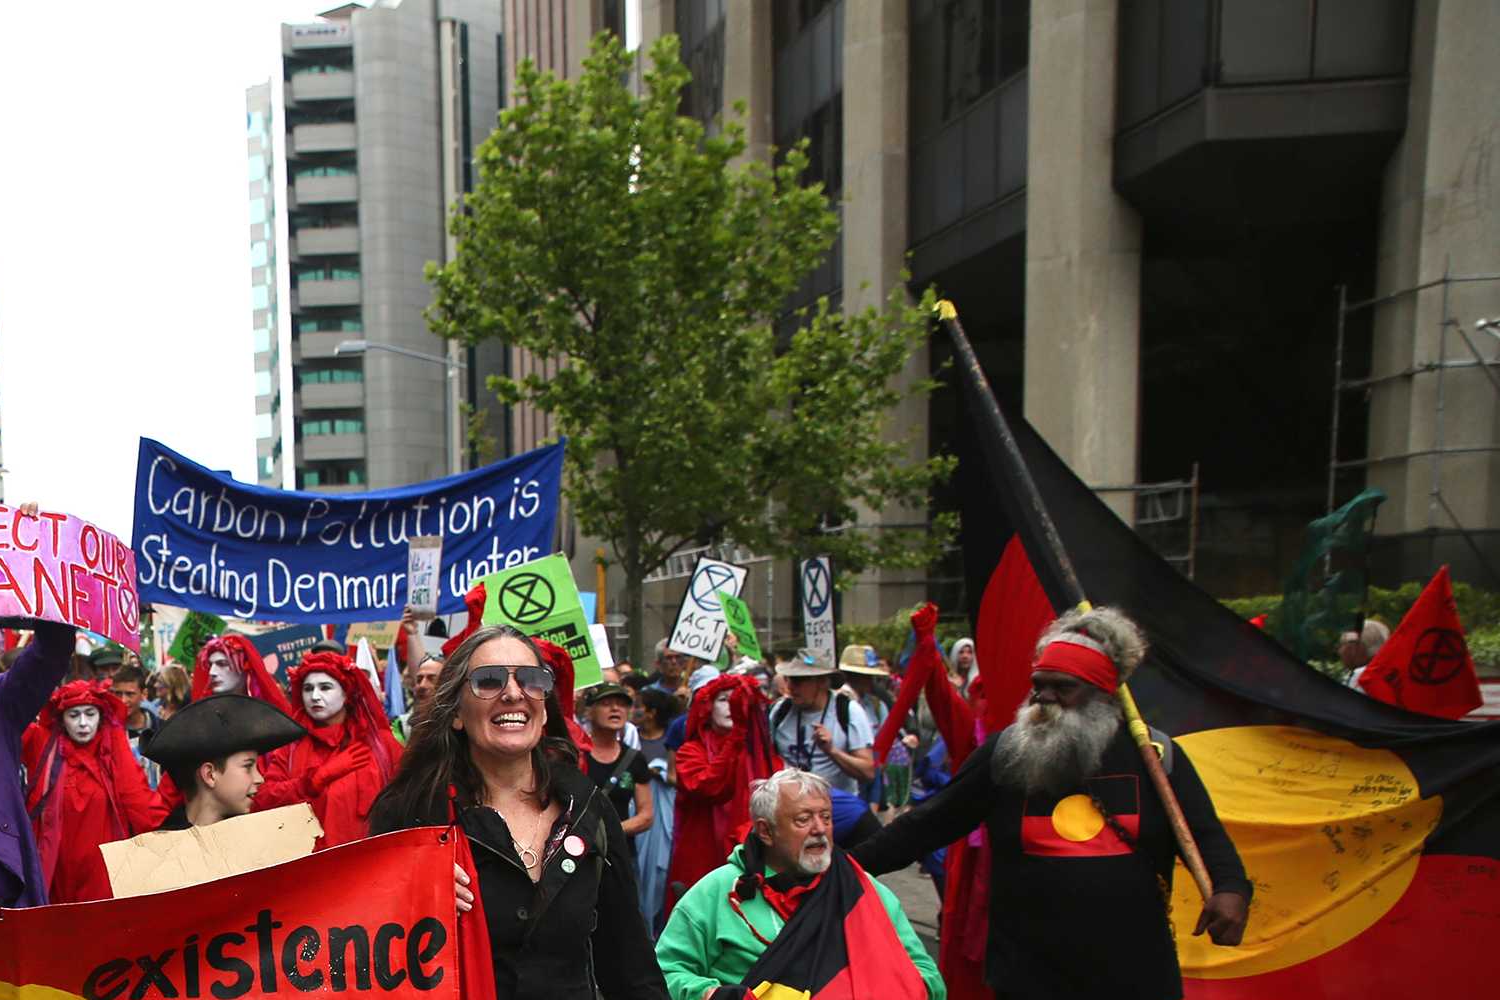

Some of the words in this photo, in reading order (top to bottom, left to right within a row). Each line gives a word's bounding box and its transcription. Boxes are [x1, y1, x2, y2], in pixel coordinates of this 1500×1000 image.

[147, 455, 286, 542] Carbon
[297, 494, 495, 550] Pollution
[508, 476, 541, 521] is
[79, 523, 131, 588] OUR
[139, 532, 259, 618] Stealing
[267, 557, 408, 613] Denmar
[673, 630, 718, 653] NOW
[680, 611, 725, 634] ACT
